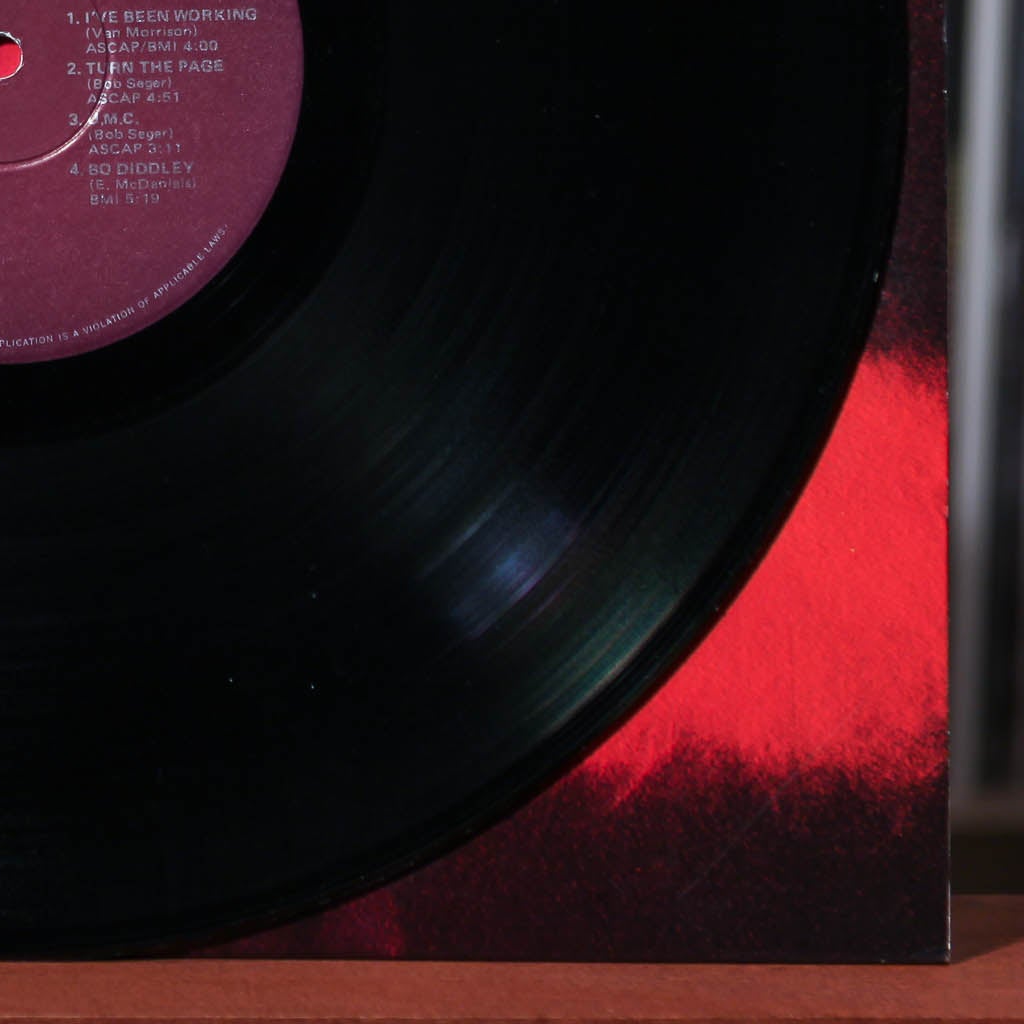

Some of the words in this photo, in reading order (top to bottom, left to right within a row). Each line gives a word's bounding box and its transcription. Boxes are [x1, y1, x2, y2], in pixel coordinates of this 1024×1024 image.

[66, 12, 80, 25] 1.
[123, 9, 169, 23] BEEN
[173, 7, 258, 22] WORKING
[125, 24, 198, 39] Morrison)
[85, 41, 177, 55] ASCAP/BMI
[183, 40, 219, 53] 4:00
[66, 62, 81, 76] 2.
[85, 61, 134, 75] TURN
[139, 61, 174, 74] THE
[178, 59, 225, 73] PAGE
[86, 93, 141, 105] ASCAP
[88, 143, 142, 155] ASCAP
[88, 162, 112, 176] BO
[117, 160, 194, 175] DIDDLEY
[89, 193, 119, 206] BMI
[58, 332, 69, 342] IS
[72, 328, 80, 338] A
[82, 306, 136, 336] VIOLATION
[137, 296, 151, 309] OF
[152, 253, 206, 300] APPLICABLE
